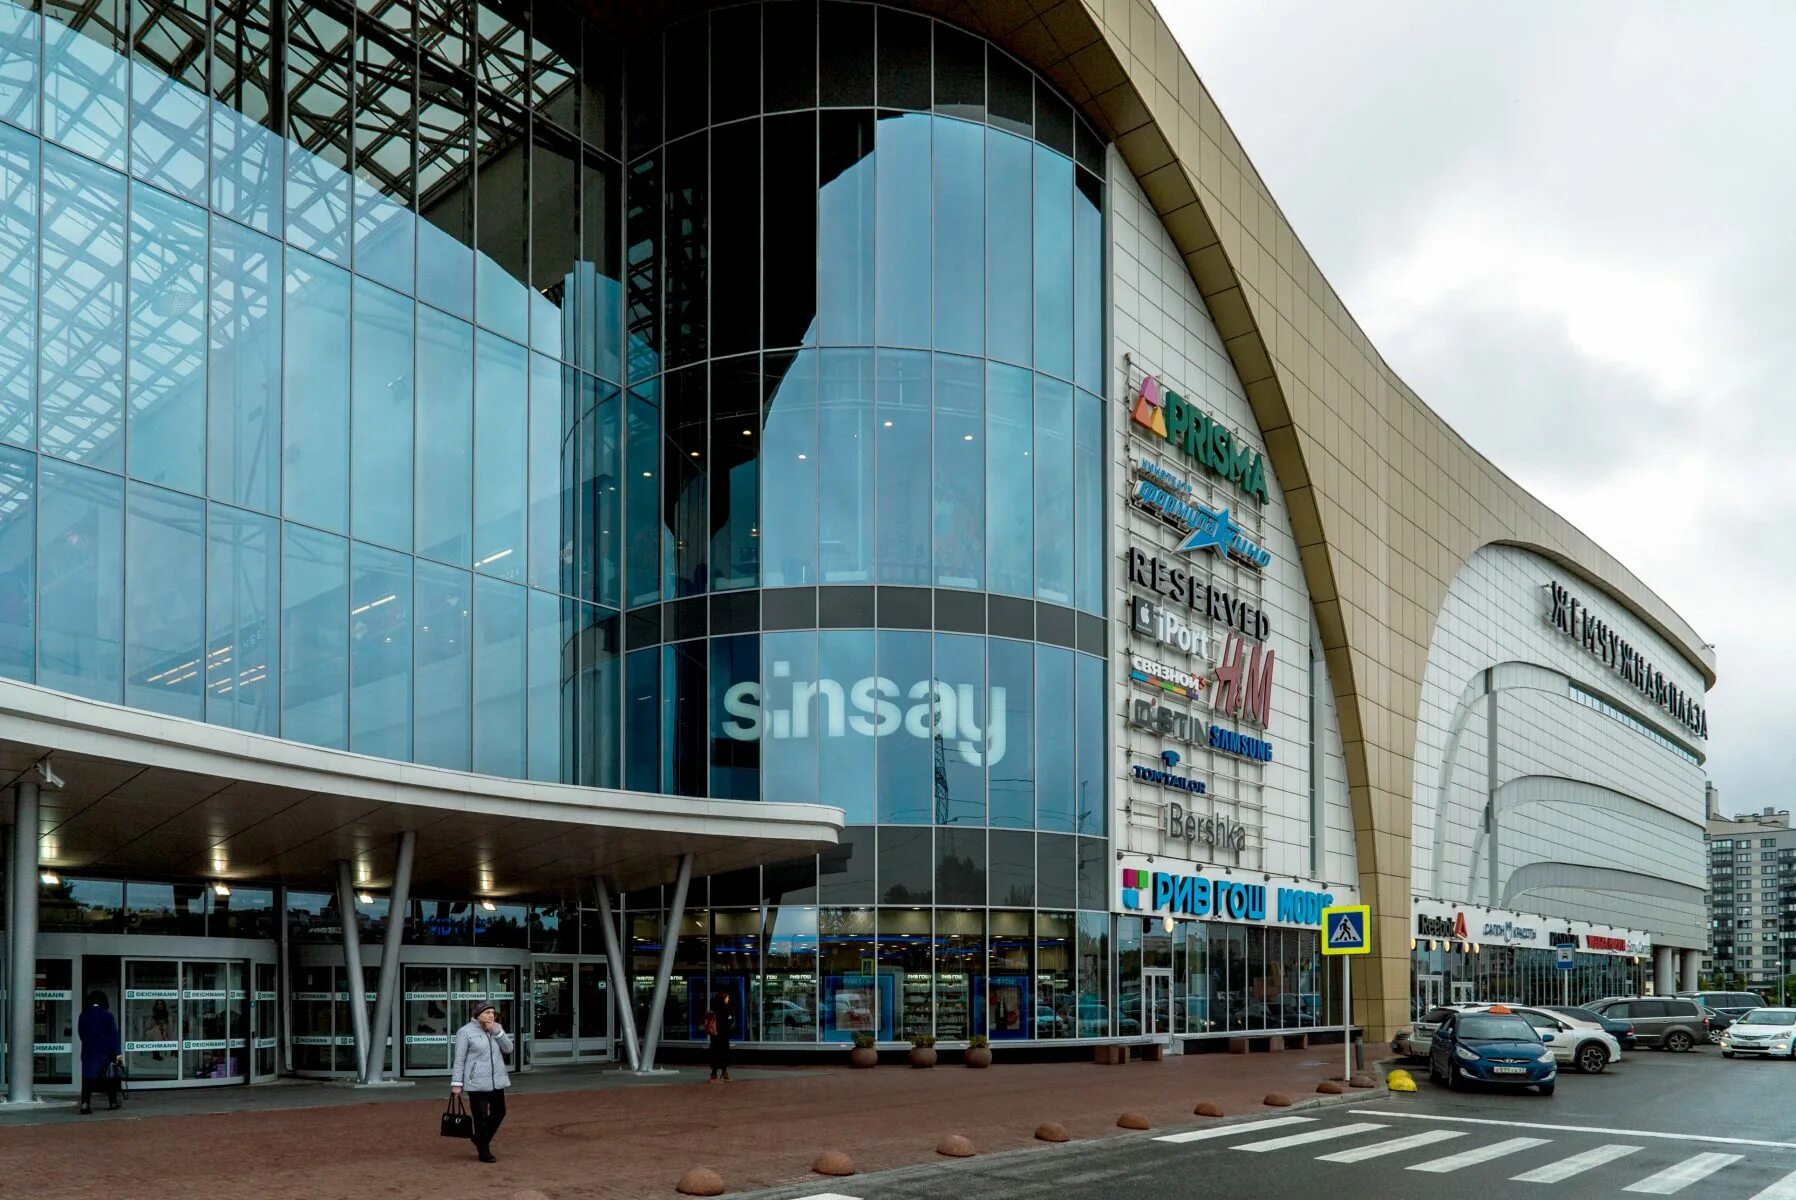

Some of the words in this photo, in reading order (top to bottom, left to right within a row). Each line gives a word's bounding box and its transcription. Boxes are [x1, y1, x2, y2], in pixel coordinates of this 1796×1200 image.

[1165, 389, 1269, 505] PRISMA
[1129, 546, 1271, 641] RESERVED
[1154, 605, 1208, 660] iPort
[1551, 580, 1667, 707] ЖЕМЧУЖНАЯ
[1668, 681, 1708, 741] ПЛАЗА
[721, 660, 1007, 767] sinsay
[1211, 631, 1275, 730] H&M
[1209, 725, 1273, 762] SAMSUNG
[1169, 801, 1246, 851] Bershka
[1153, 871, 1210, 916] РИВ
[1213, 880, 1266, 920] ГОШ
[1418, 913, 1457, 939] Reebok
